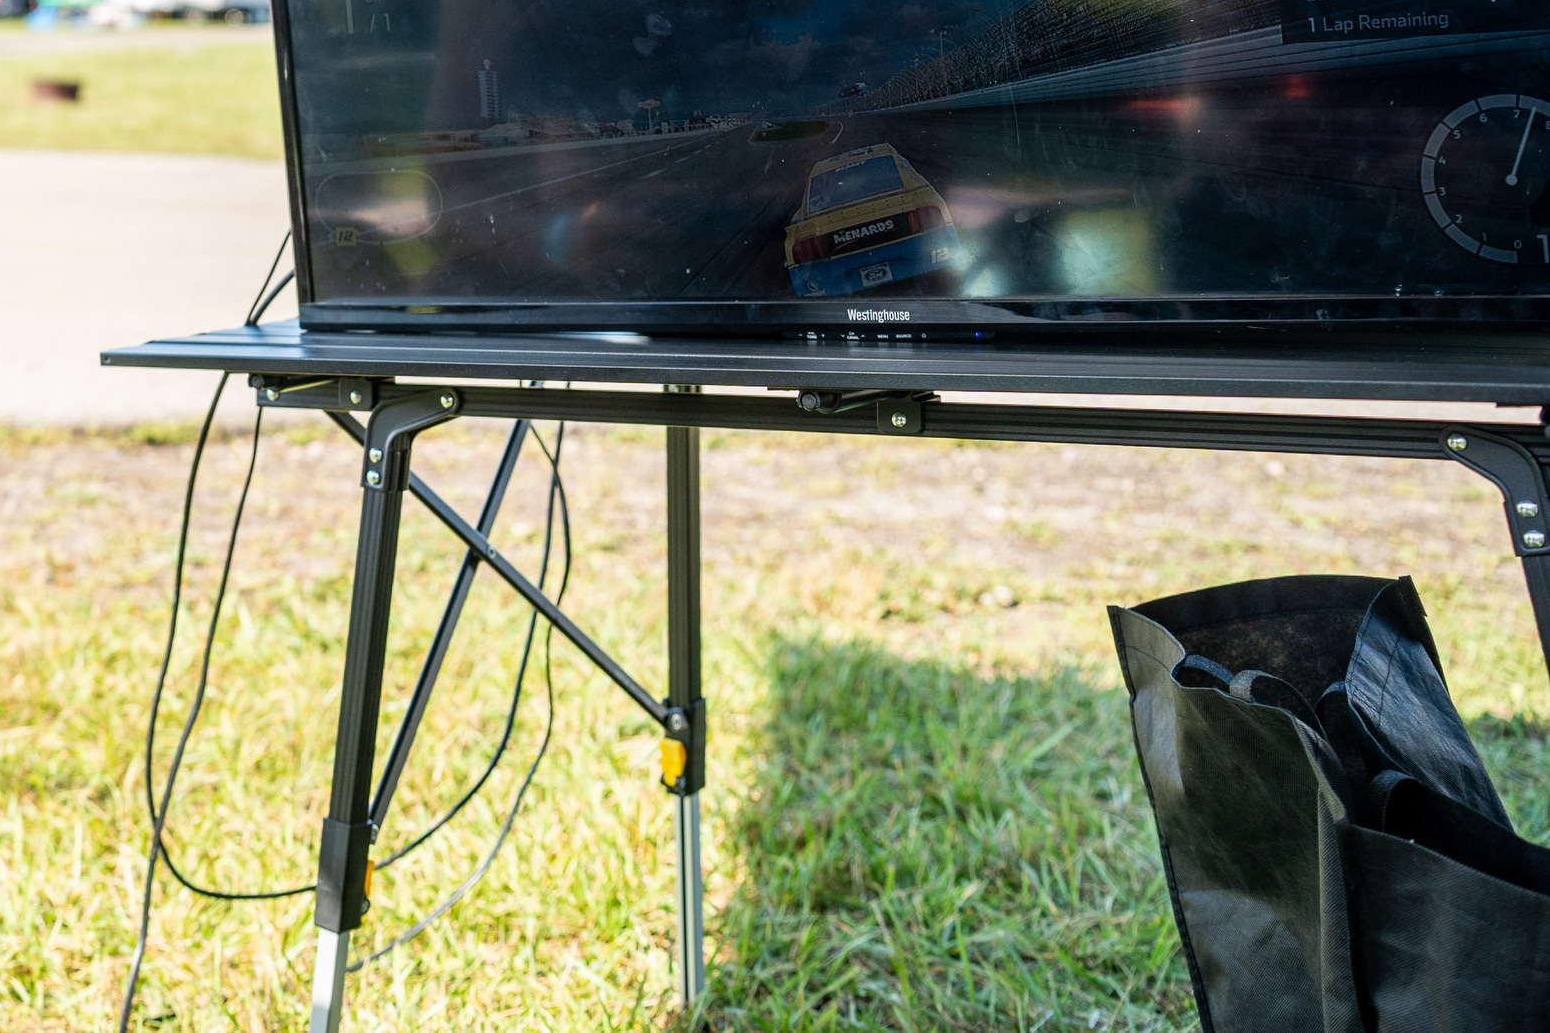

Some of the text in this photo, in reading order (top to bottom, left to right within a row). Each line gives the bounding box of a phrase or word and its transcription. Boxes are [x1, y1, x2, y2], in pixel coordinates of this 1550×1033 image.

[1308, 10, 1449, 34] 1 Lap Remaining
[832, 219, 895, 244] MENARDS
[847, 309, 911, 324] Westinghouse
